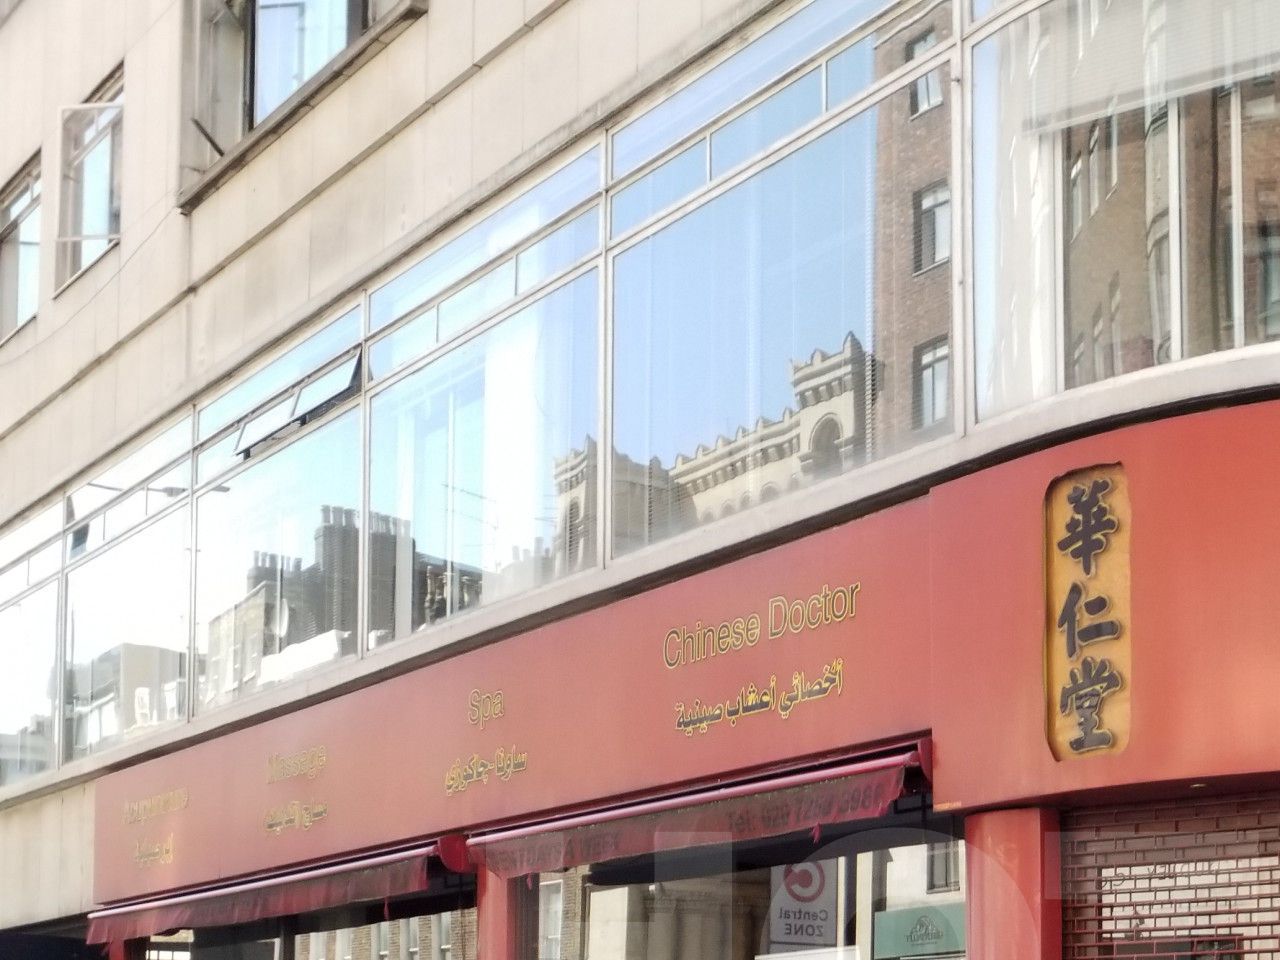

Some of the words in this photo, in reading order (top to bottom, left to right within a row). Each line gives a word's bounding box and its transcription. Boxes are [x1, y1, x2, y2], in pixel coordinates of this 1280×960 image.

[662, 610, 761, 670] Chinese
[767, 581, 861, 641] Doctor
[1056, 477, 1124, 753] 華仁堂
[467, 687, 505, 730] Spa
[265, 744, 328, 785] Massage
